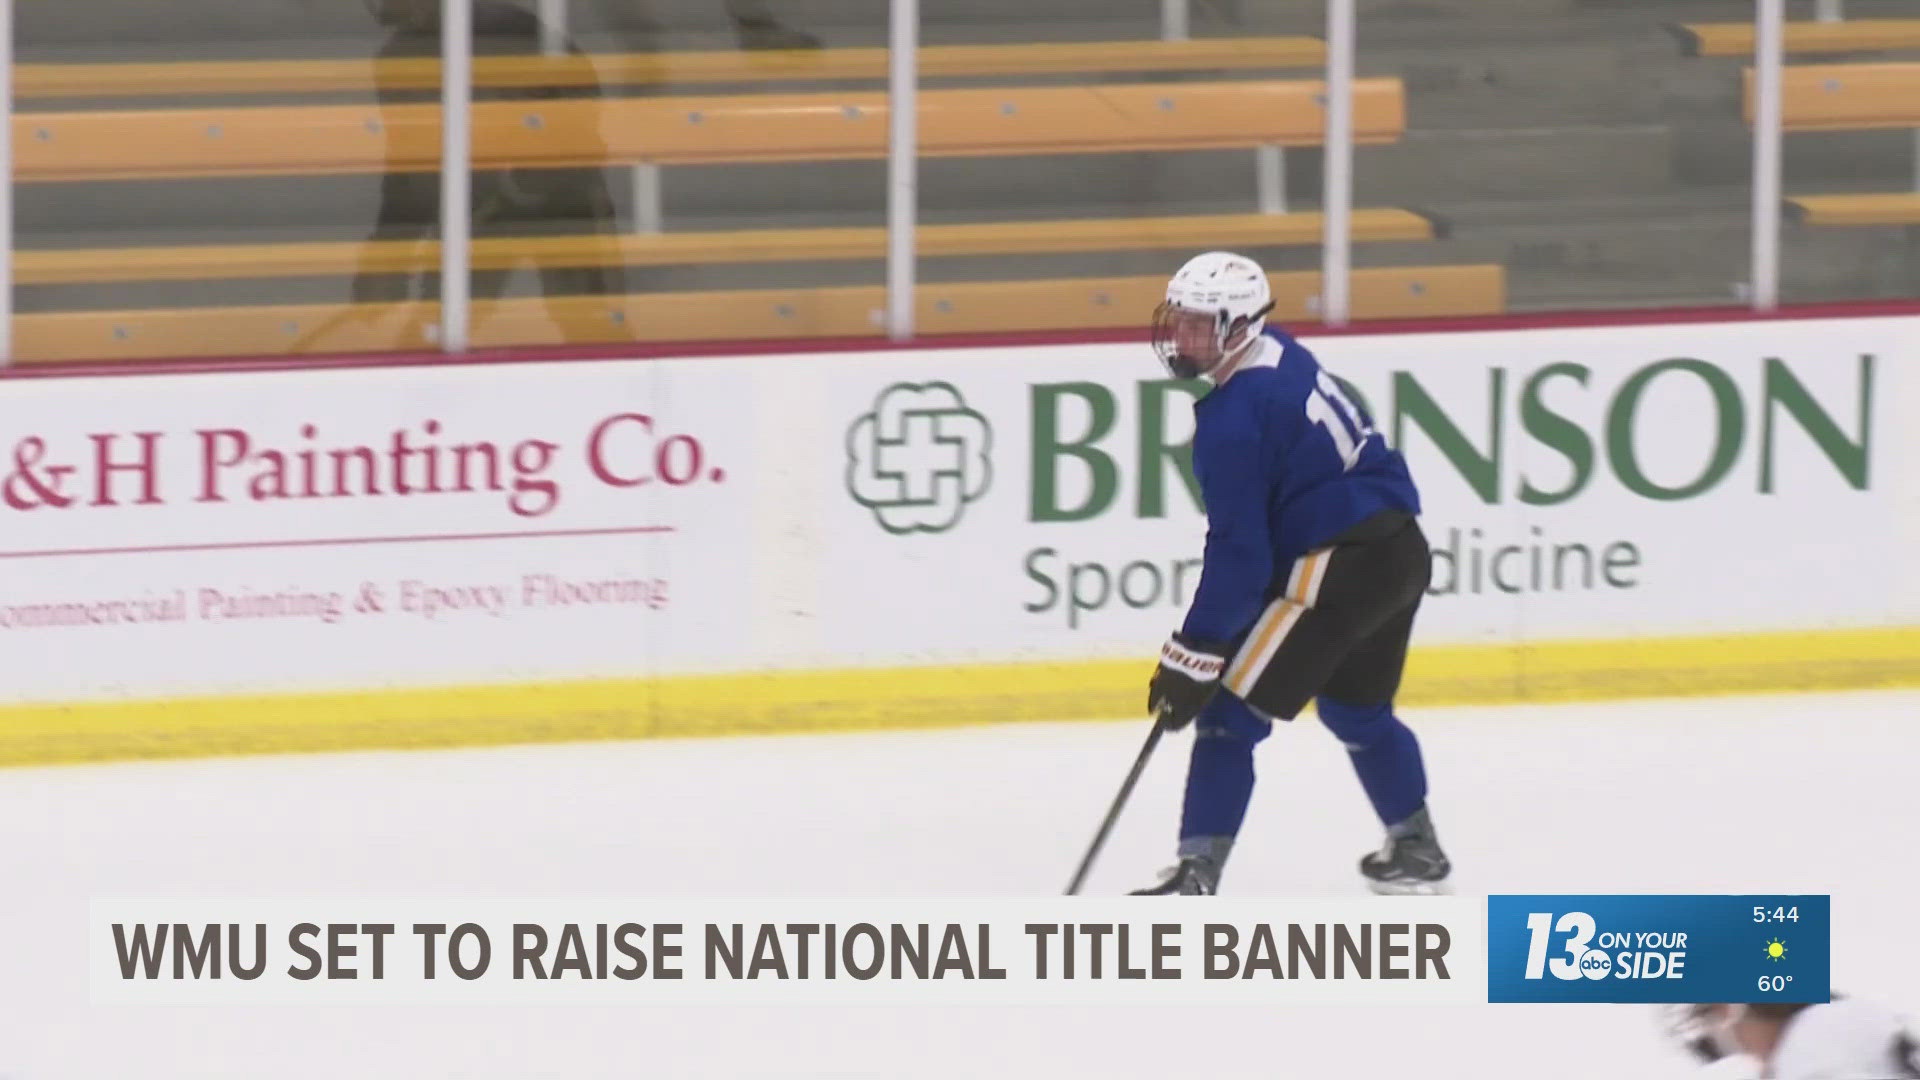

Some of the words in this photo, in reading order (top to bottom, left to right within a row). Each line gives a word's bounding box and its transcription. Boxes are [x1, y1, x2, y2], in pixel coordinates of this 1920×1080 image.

[197, 420, 561, 517] Painting
[586, 413, 727, 489] Co.
[1026, 354, 1877, 523] BRNSON
[199, 585, 344, 624] Painting
[353, 581, 384, 615] &
[399, 580, 510, 620] Epoxy
[521, 574, 670, 611] Flooring
[1023, 547, 1204, 630] Spor
[1425, 526, 1642, 596] dicine
